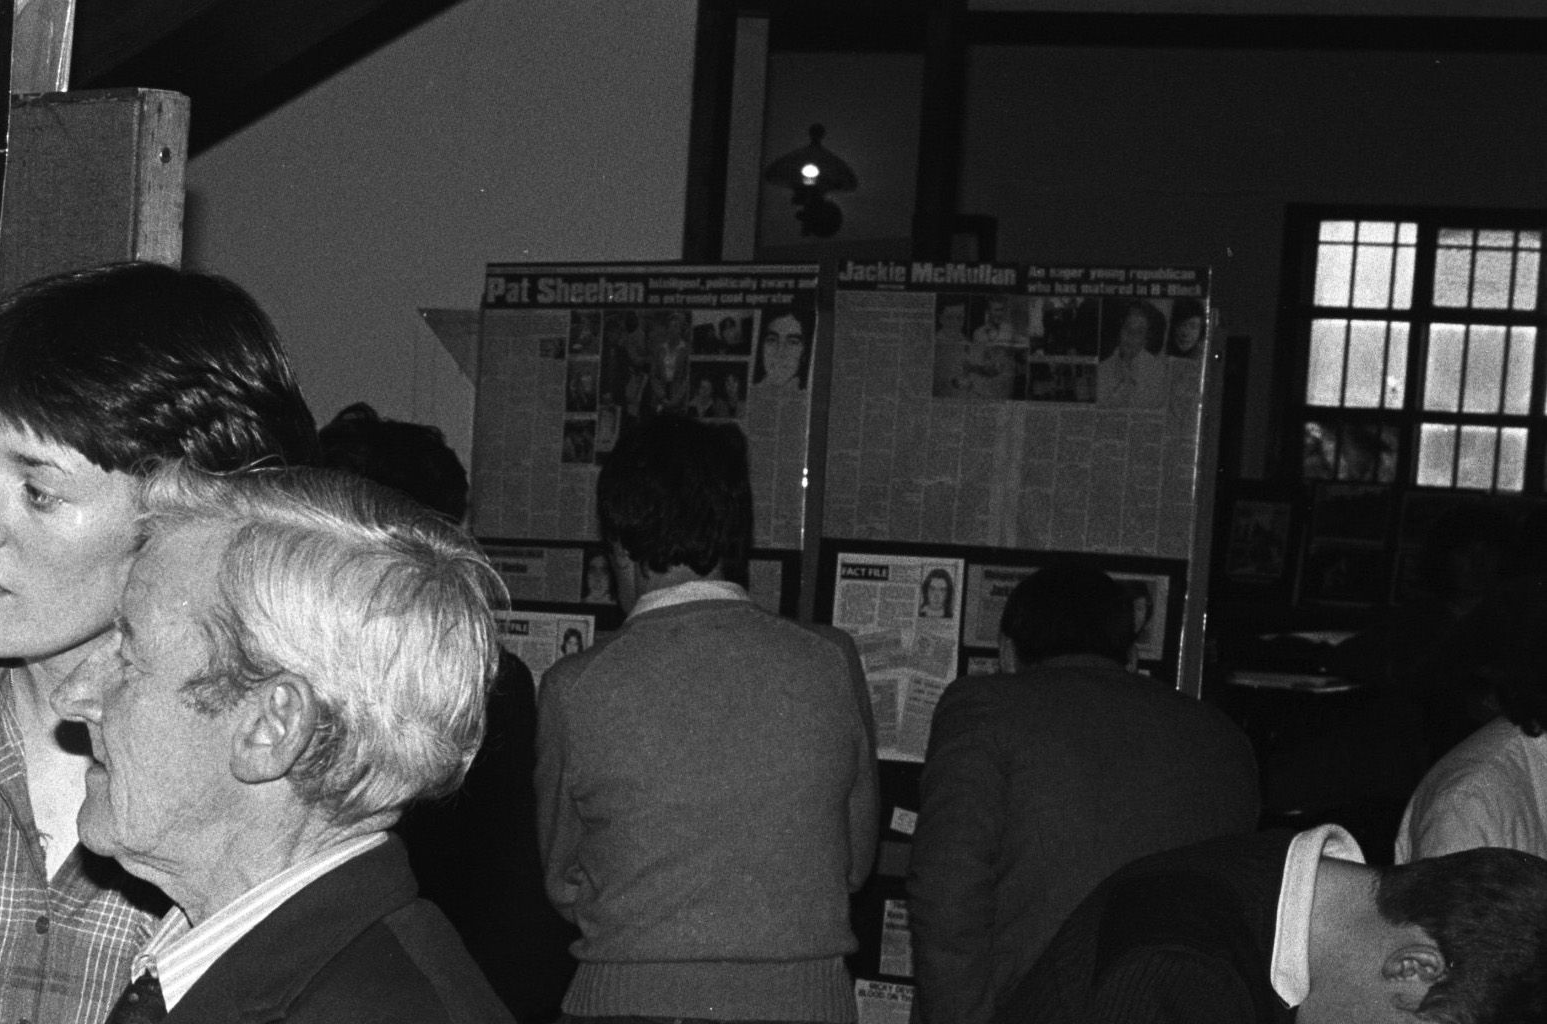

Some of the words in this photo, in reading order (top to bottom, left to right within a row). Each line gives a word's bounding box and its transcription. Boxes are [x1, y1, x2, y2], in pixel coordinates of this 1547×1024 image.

[839, 262, 906, 284] Jackie
[911, 262, 1016, 286] McMullan
[1129, 268, 1196, 281] republican
[486, 277, 531, 303] Pat
[537, 276, 645, 304] Sheehan
